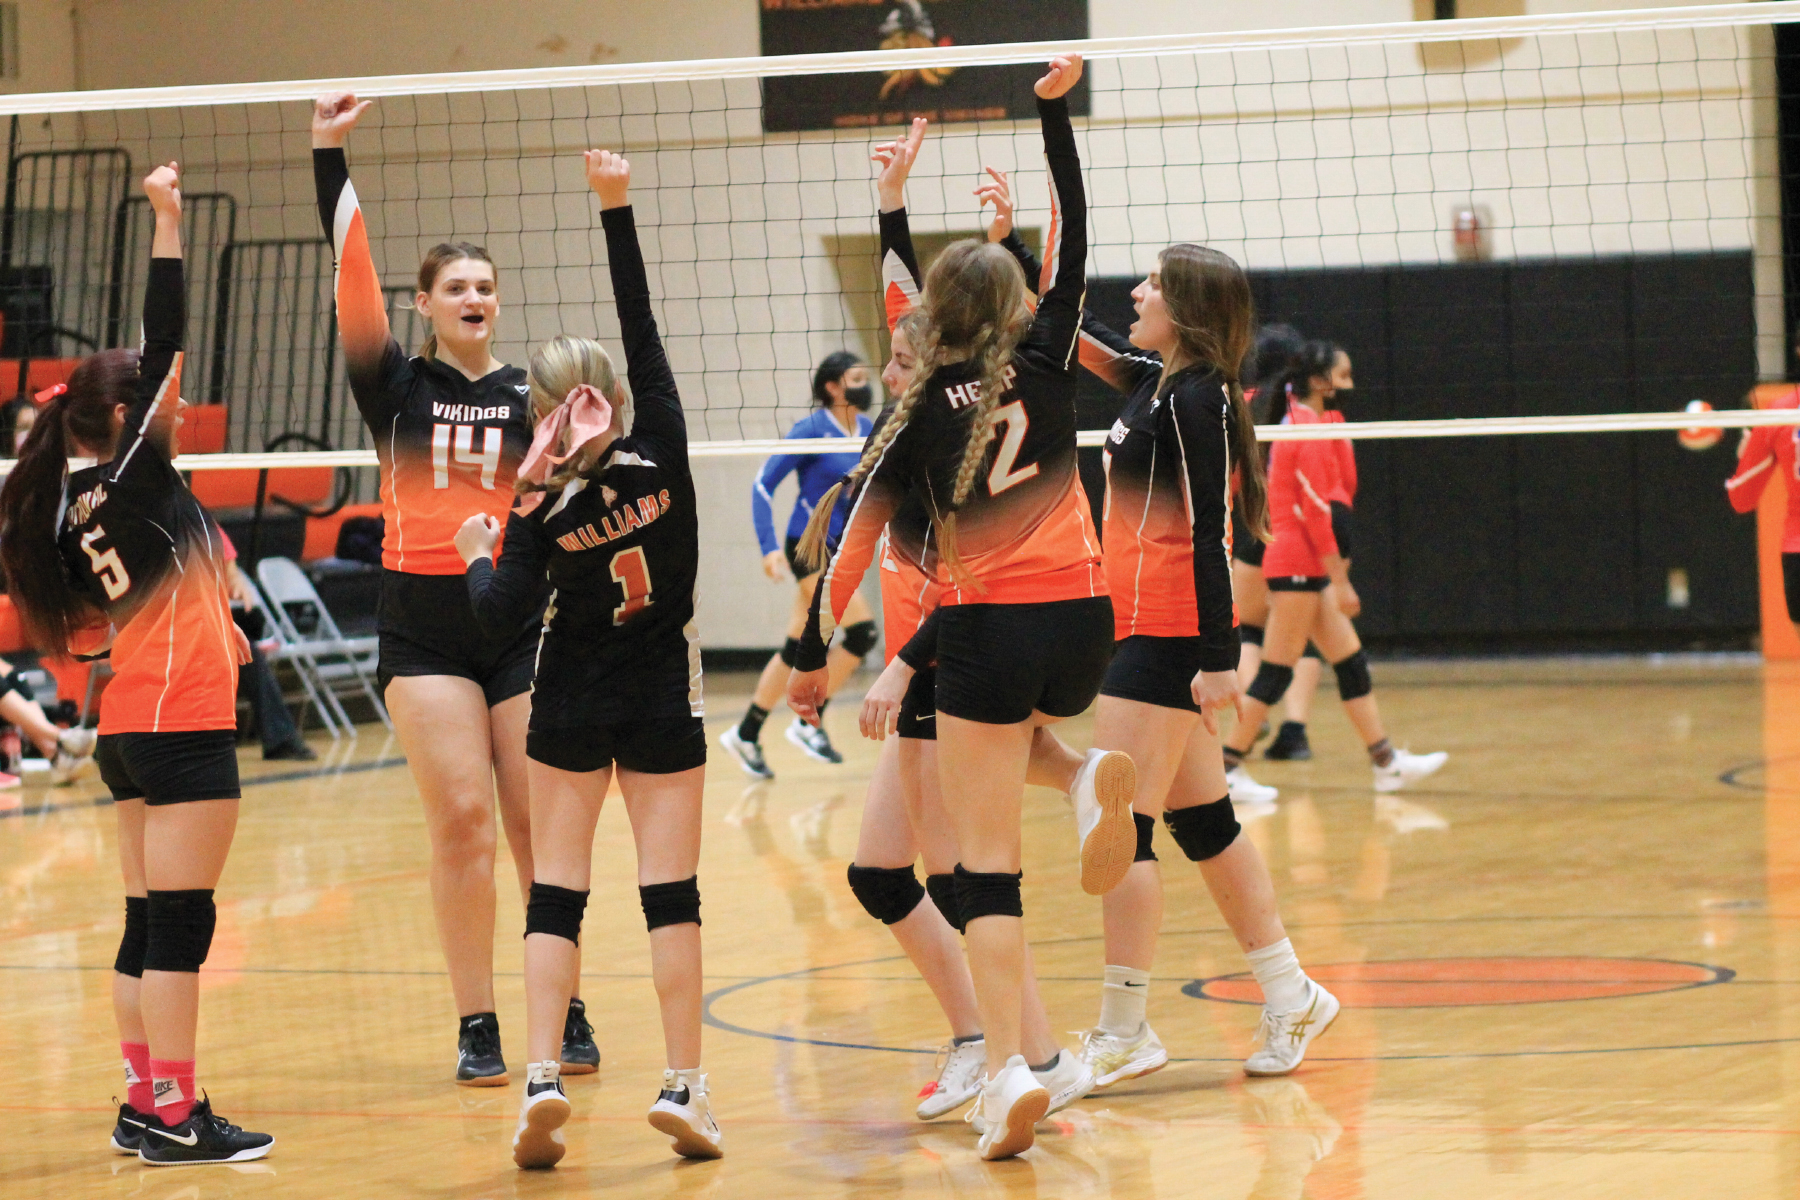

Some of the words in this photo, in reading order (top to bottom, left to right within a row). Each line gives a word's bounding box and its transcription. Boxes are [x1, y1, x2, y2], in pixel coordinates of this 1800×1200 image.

[432, 401, 510, 421] VIKINGS
[431, 423, 503, 490] 14
[974, 400, 1039, 496] 2
[556, 488, 671, 552] WILLIAMS
[80, 524, 131, 601] 5
[609, 545, 655, 627] 1
